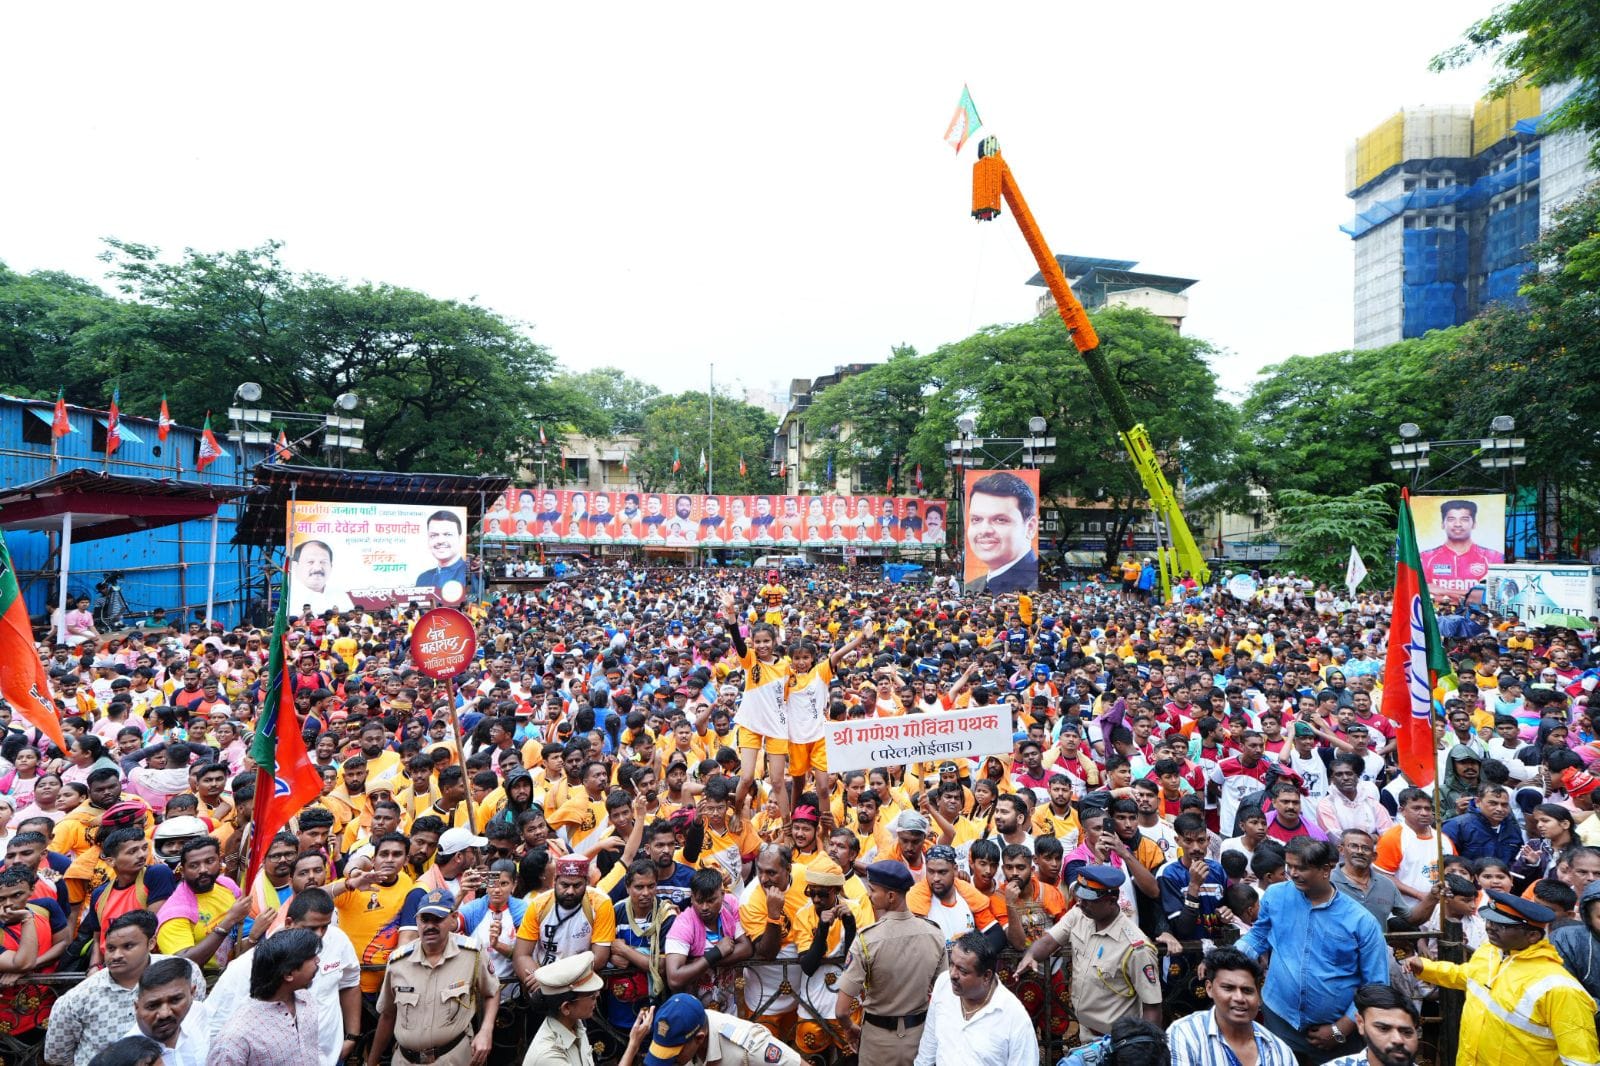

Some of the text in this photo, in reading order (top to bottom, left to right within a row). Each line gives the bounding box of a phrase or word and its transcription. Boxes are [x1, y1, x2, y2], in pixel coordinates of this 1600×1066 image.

[331, 504, 358, 516] जनता
[375, 521, 420, 535] फडणवीस
[834, 715, 998, 747] श्री गणेश गोविंदा पथक
